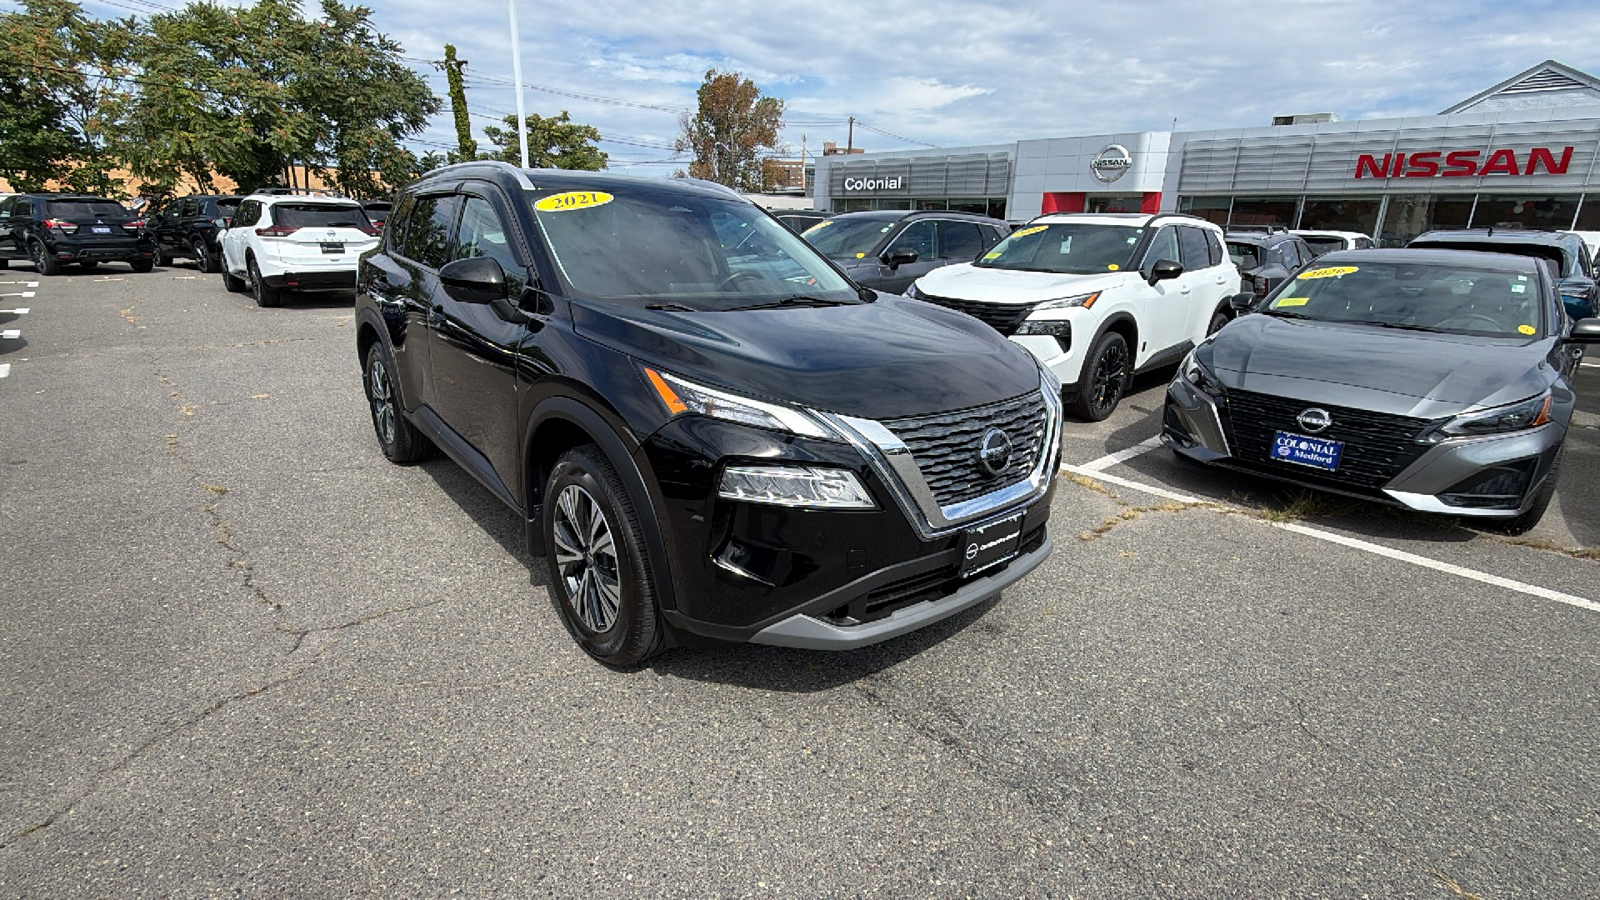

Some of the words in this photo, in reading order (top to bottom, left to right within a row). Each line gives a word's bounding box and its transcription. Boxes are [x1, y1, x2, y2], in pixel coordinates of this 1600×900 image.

[1093, 159, 1127, 167] NISSAN
[1355, 146, 1574, 179] NISSAN
[844, 176, 902, 191] Colonial
[551, 192, 599, 209] 2021
[1277, 437, 1337, 456] COLONIAL
[1294, 450, 1333, 464] Medford
